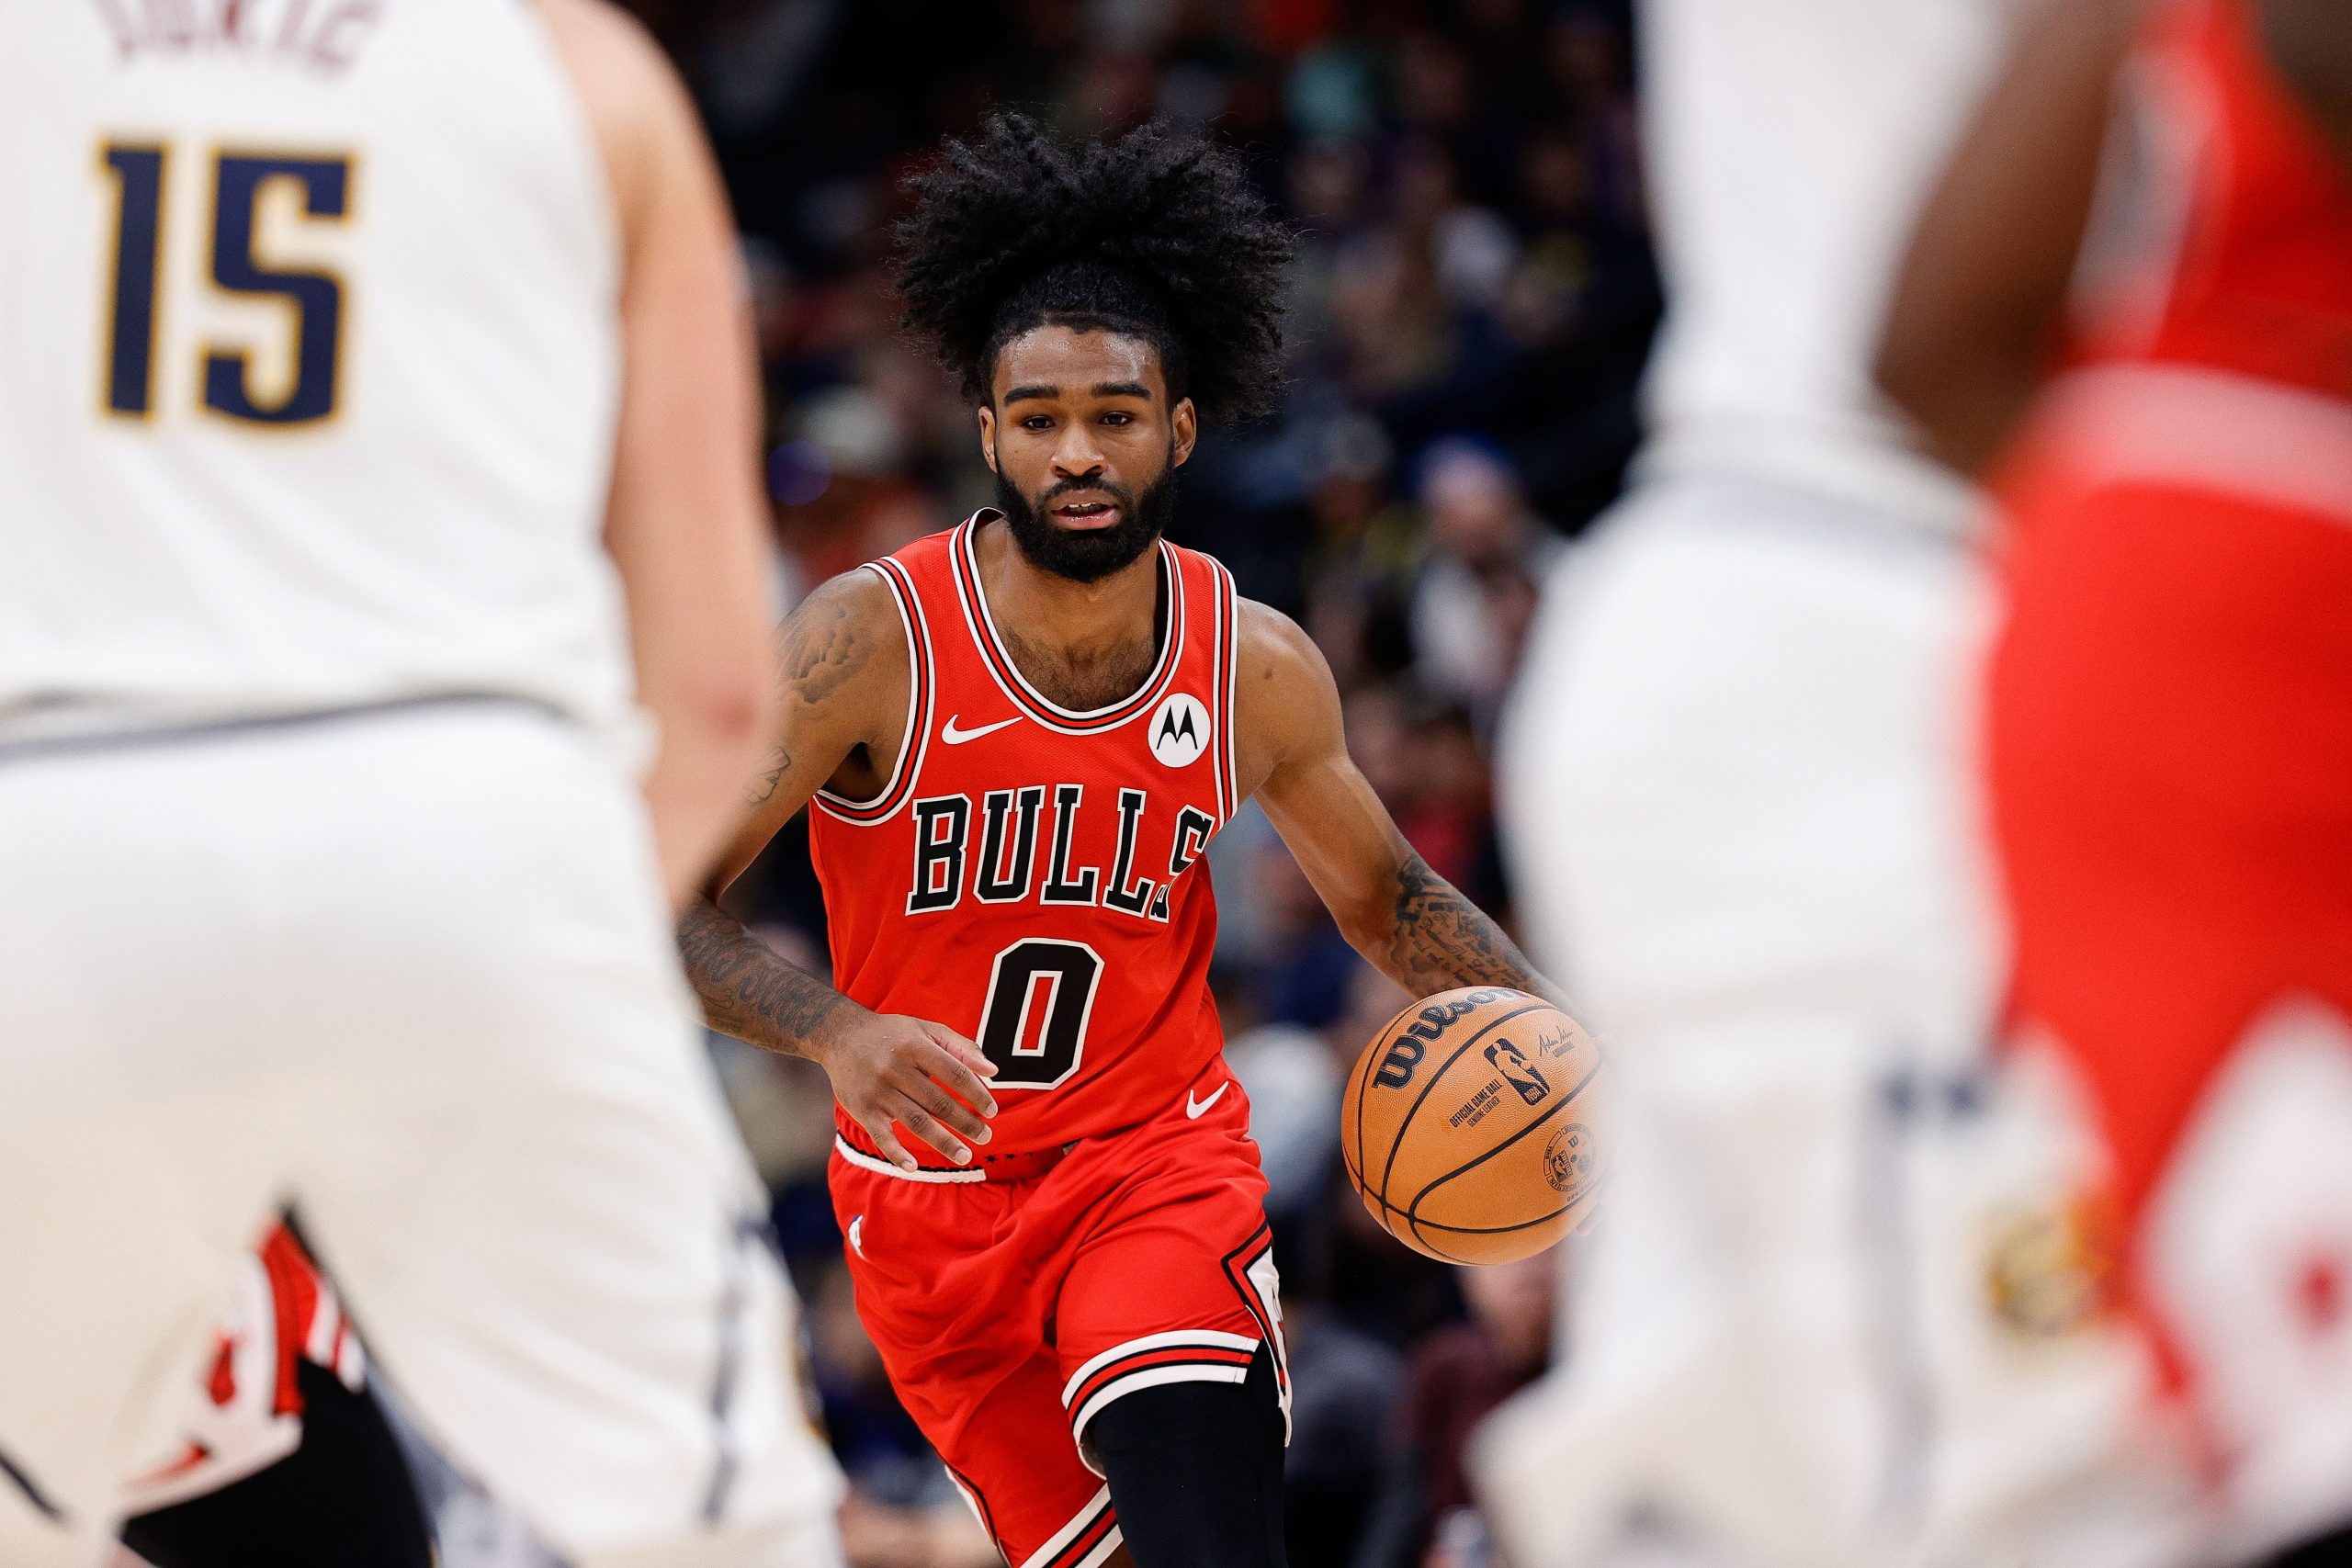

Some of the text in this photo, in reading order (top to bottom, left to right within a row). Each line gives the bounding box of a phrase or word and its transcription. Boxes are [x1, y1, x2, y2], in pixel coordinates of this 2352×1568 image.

[98, 133, 357, 432] 15
[905, 784, 1216, 923] BULLS
[975, 937, 1105, 1090] 0
[1449, 1101, 1476, 1128] OFFICIAL
[1471, 1089, 1490, 1108] GAME
